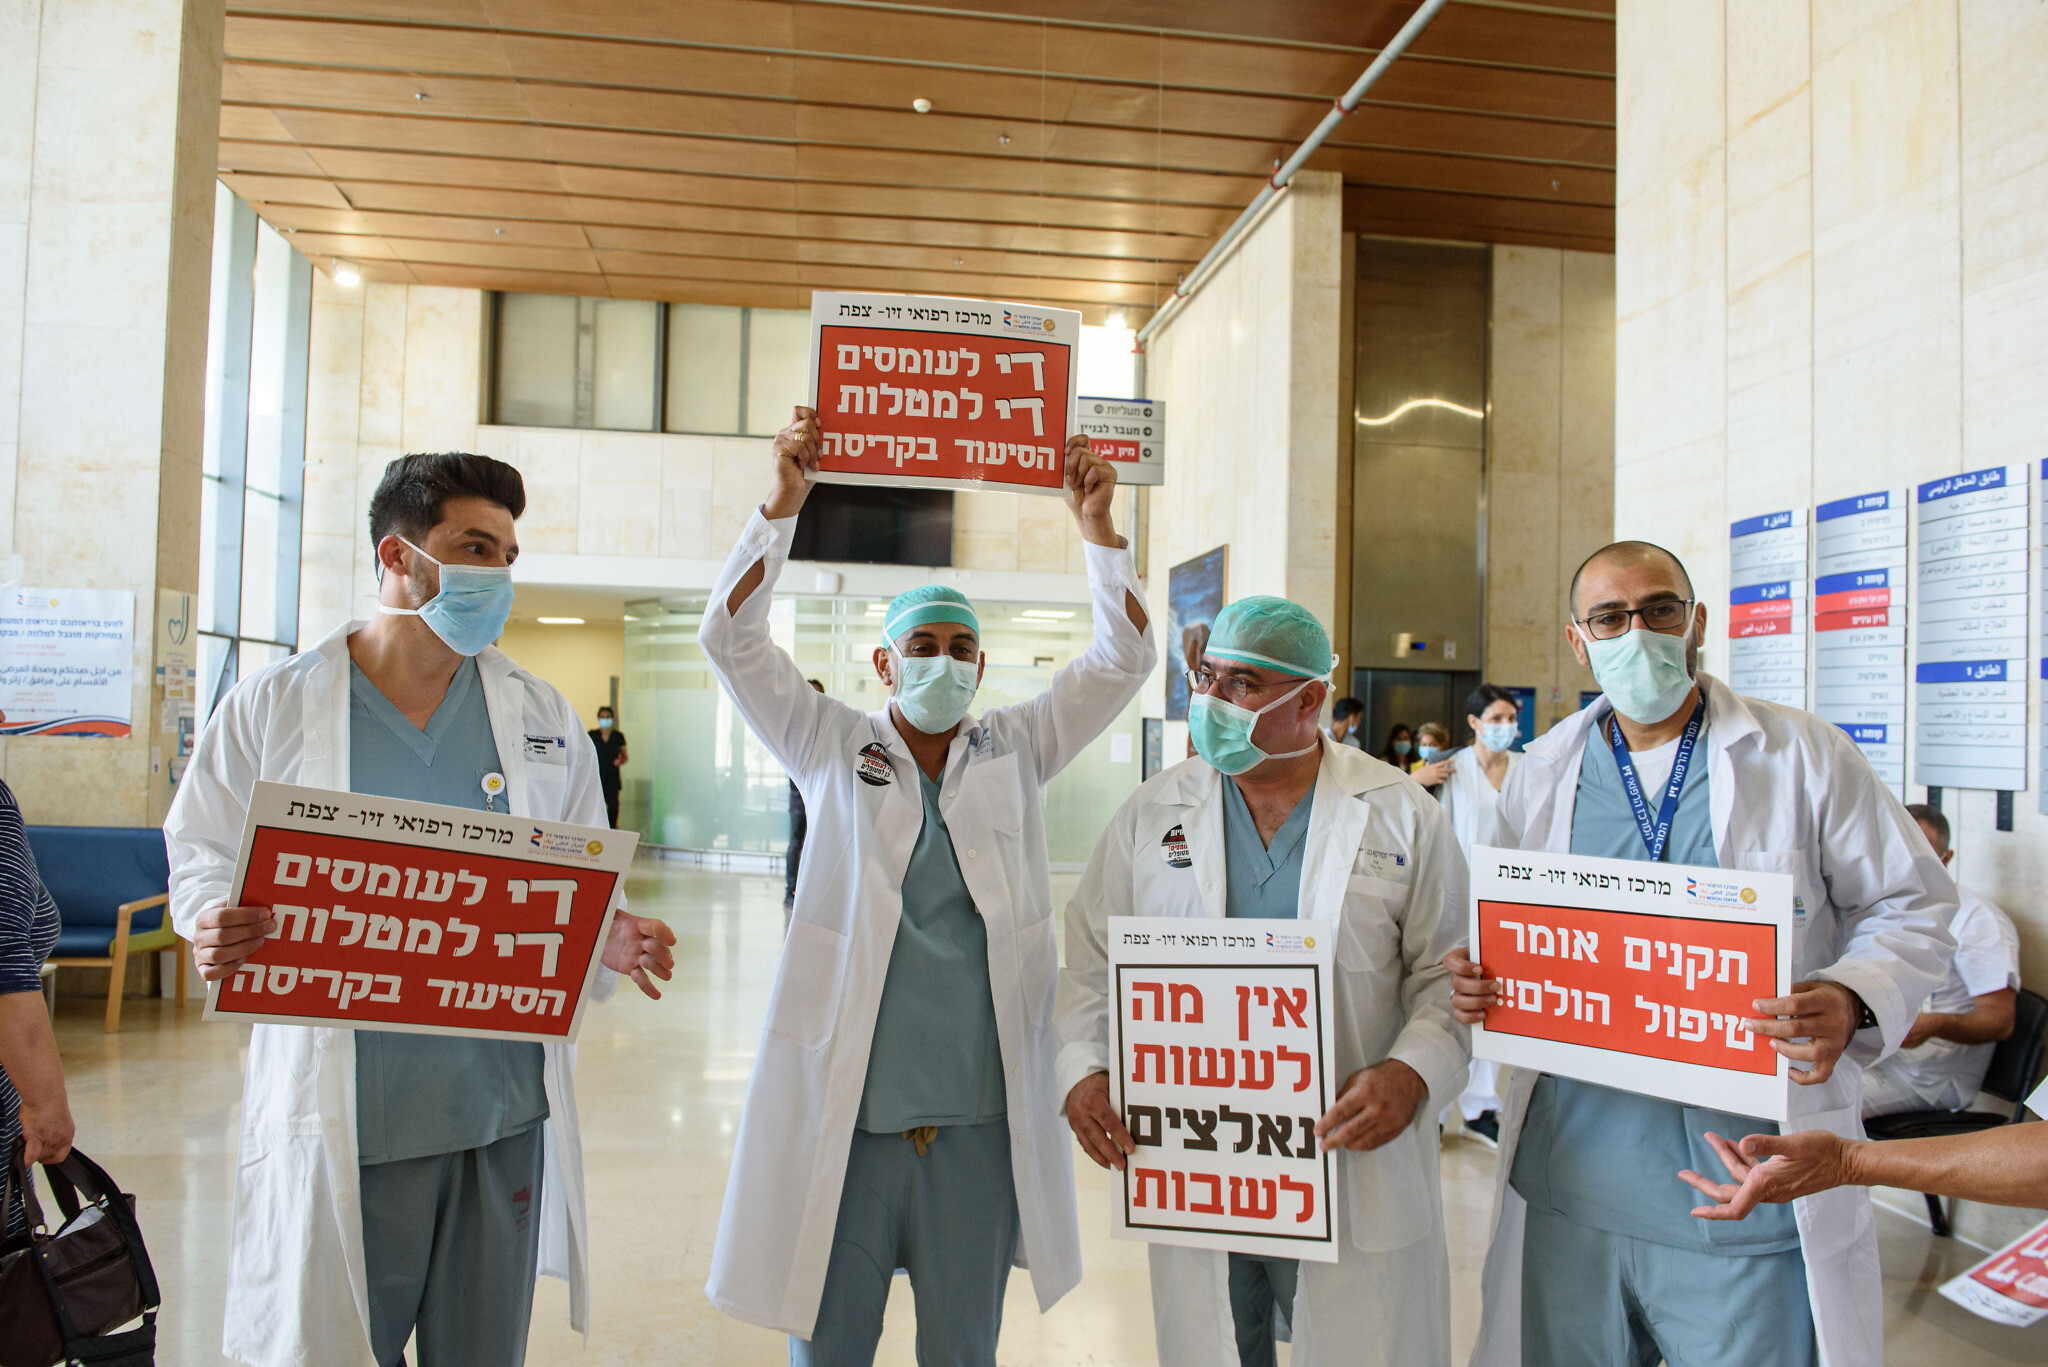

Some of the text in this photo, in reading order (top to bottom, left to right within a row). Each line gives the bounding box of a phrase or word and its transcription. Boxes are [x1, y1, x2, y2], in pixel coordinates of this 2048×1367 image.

[839, 304, 872, 317] צפת
[907, 307, 949, 322] רפואי
[955, 310, 991, 325] מרכז
[837, 344, 1045, 391] די לעומסים
[837, 383, 1044, 437] די למטלות
[1106, 404, 1141, 416] מעליות
[1080, 423, 1140, 437] מעבר לבניין
[822, 431, 1055, 471] הסיעוד בקריסה
[1118, 446, 1135, 459] מיון
[1864, 496, 1885, 507] קומה
[1864, 574, 1885, 585] קומה
[60, 619, 100, 627] בריאותכם
[104, 620, 123, 628] למען
[1852, 614, 1886, 625] מיון עיניים
[58, 630, 82, 638] מוגבל
[85, 631, 122, 640] במחלקות
[1862, 729, 1883, 740] קומה
[1668, 721, 1699, 798] המרכז הרפואי זיו
[287, 801, 339, 822] צפת
[1622, 765, 1654, 841] המרכז הרפואי זיו
[394, 814, 453, 837] רפואי
[463, 822, 513, 845] מרכז
[1653, 822, 1668, 855] המרכז
[1168, 850, 1190, 858] מטופלים
[1498, 863, 1533, 880] צפת
[1572, 870, 1621, 892] רפואי
[274, 852, 578, 925] די לעומסים
[1627, 877, 1672, 896] מרכז
[270, 903, 564, 977] די למטלות
[1123, 932, 1151, 946] צפת
[1181, 934, 1218, 948] רפואי
[1222, 934, 1256, 948] מרכז
[1499, 920, 1748, 991] תקנים אומר
[231, 963, 567, 1016] הסיעוד בקריסה
[1132, 981, 1309, 1041] אין מה
[1495, 976, 1755, 1052] טיפול הולם!!
[1132, 1043, 1312, 1093] לעשות
[1127, 1104, 1317, 1160] נאלצים
[1133, 1167, 1314, 1223] לשבות
